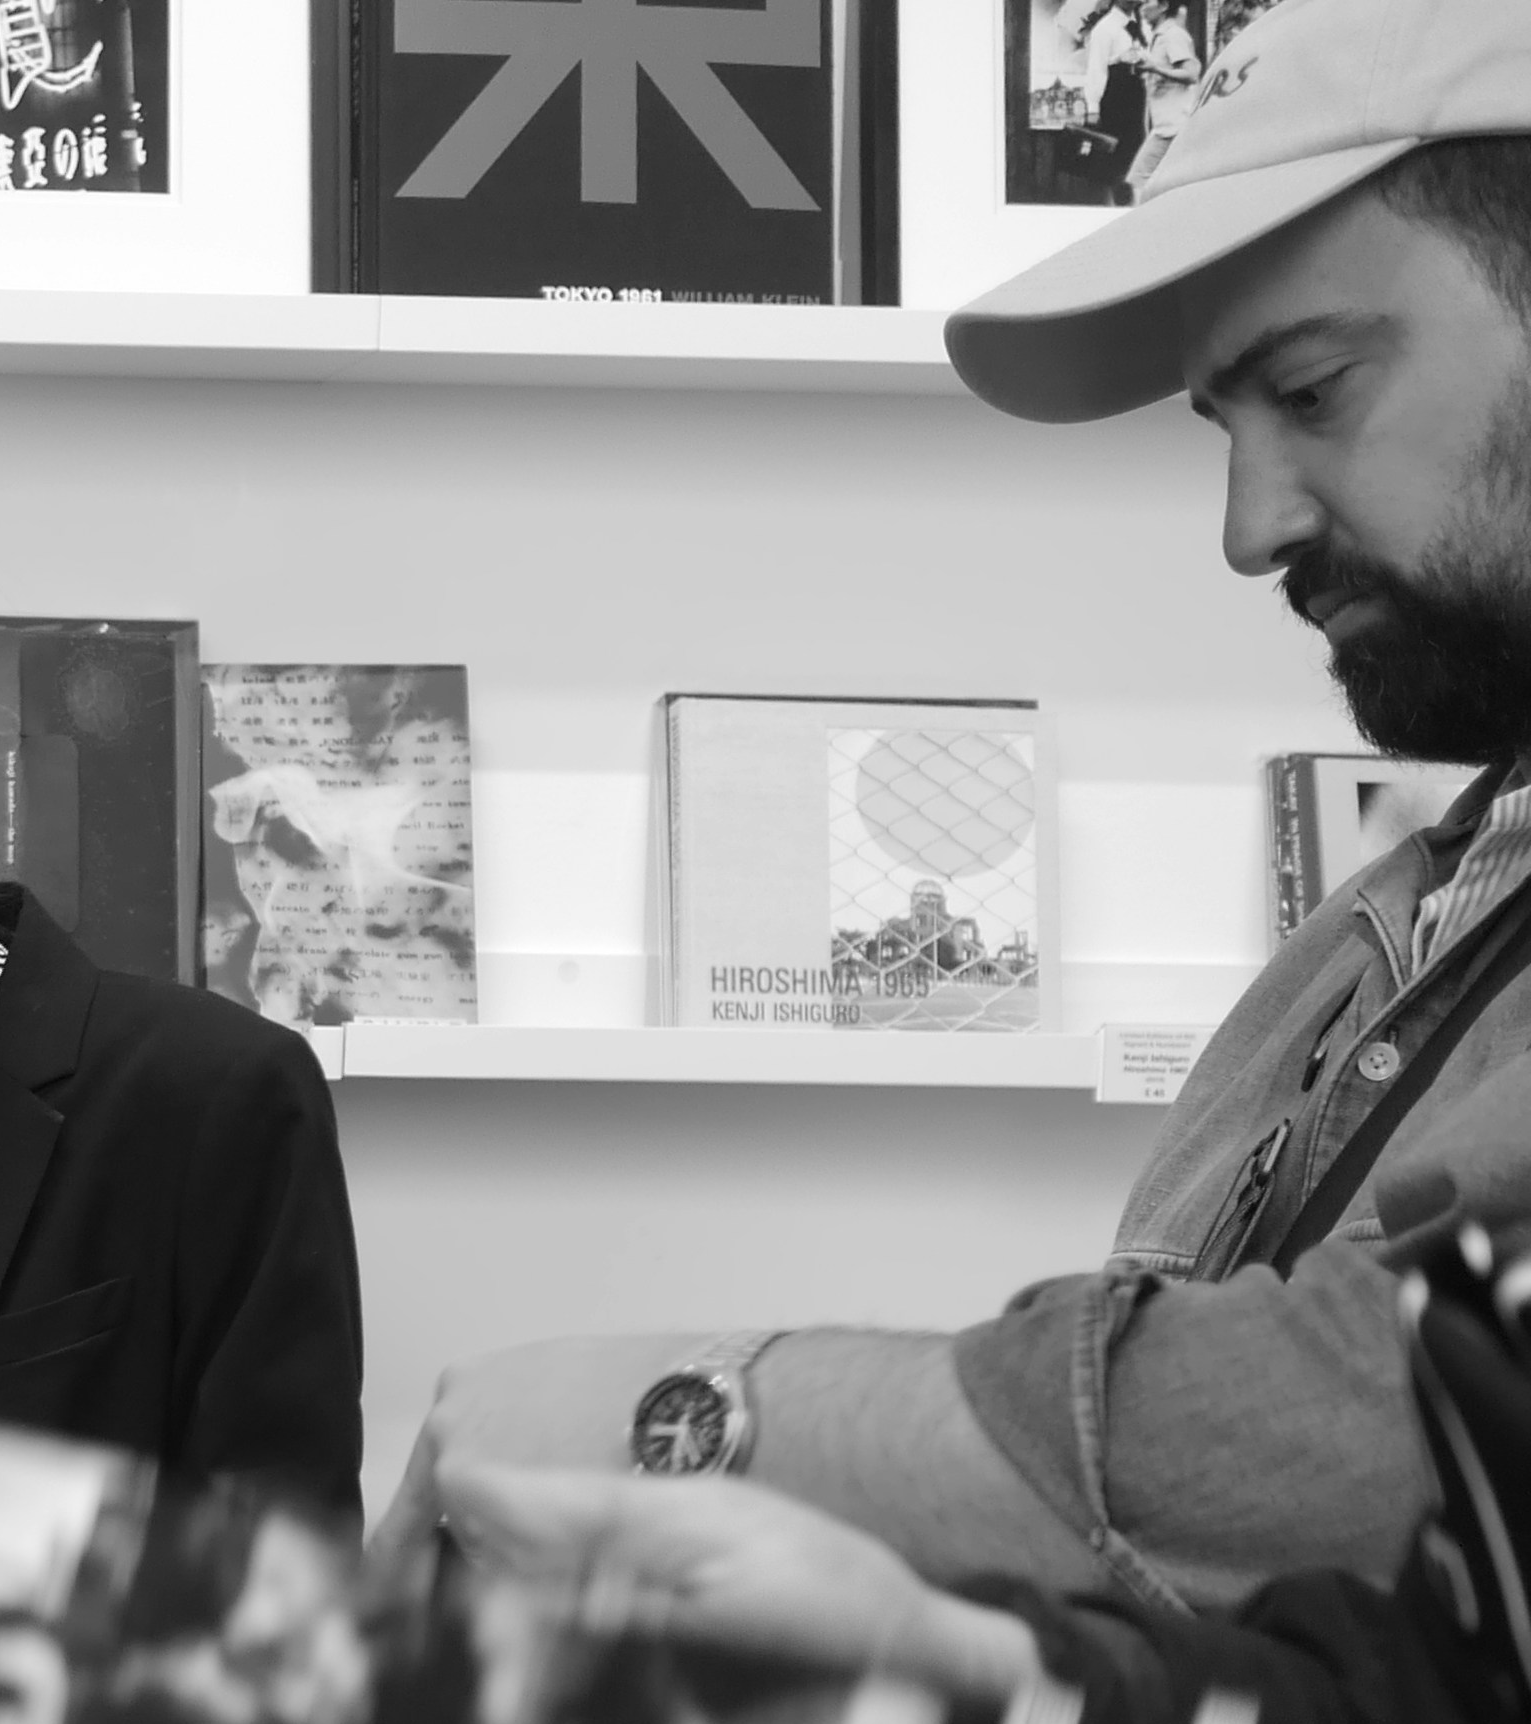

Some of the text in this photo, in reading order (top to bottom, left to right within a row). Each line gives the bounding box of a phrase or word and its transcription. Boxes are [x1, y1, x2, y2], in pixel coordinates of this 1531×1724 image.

[541, 286, 593, 303] TOKYO
[617, 288, 662, 304] 1961
[710, 966, 931, 998] HIROSHIMA 1965
[712, 1000, 861, 1024] KENJI ISHIGURO
